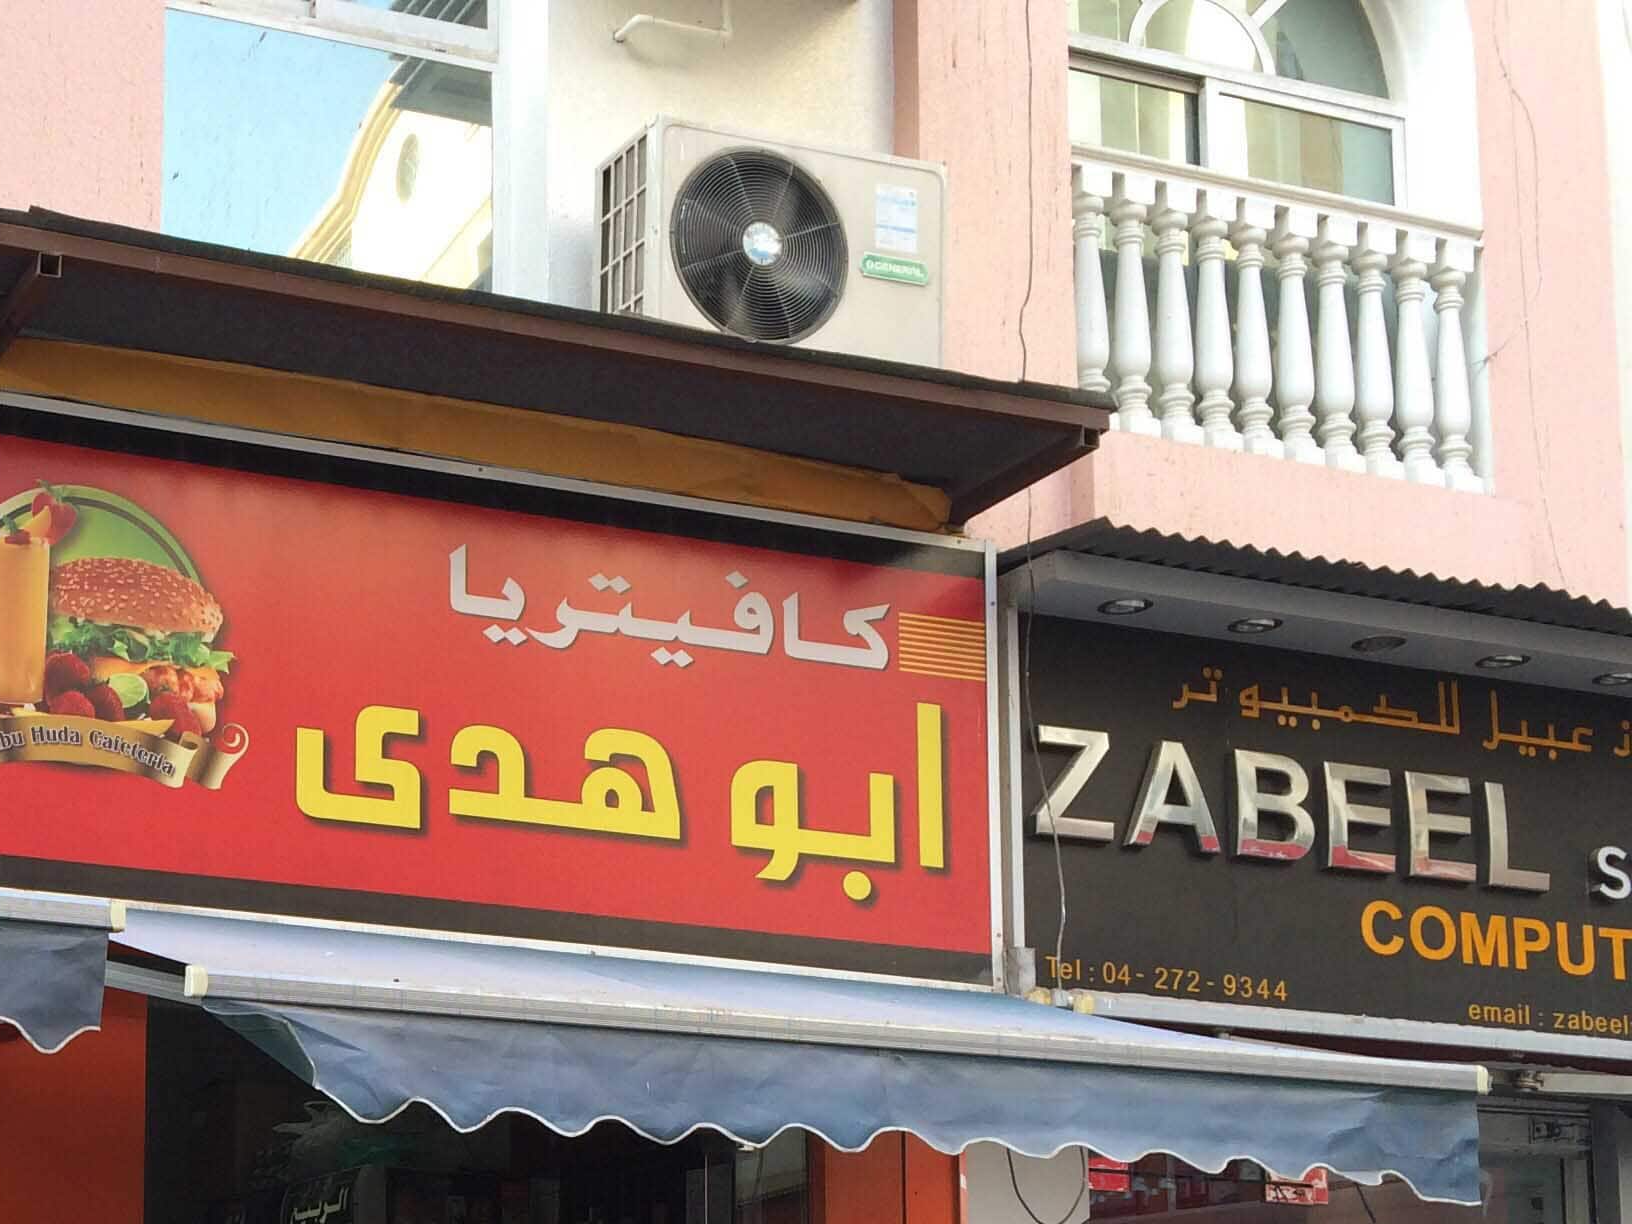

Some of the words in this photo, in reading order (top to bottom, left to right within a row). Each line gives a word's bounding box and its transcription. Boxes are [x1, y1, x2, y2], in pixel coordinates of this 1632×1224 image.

[448, 544, 891, 670] كافيتريا
[30, 725, 82, 745] Huda
[88, 729, 176, 777] Cafeteria
[295, 704, 682, 840] هدى
[730, 701, 945, 901] ابو
[1031, 723, 1551, 892] ZABEEL
[1360, 899, 1632, 982] COMPUT
[1468, 1003, 1531, 1026] email
[1552, 1009, 1632, 1036] zabeel
